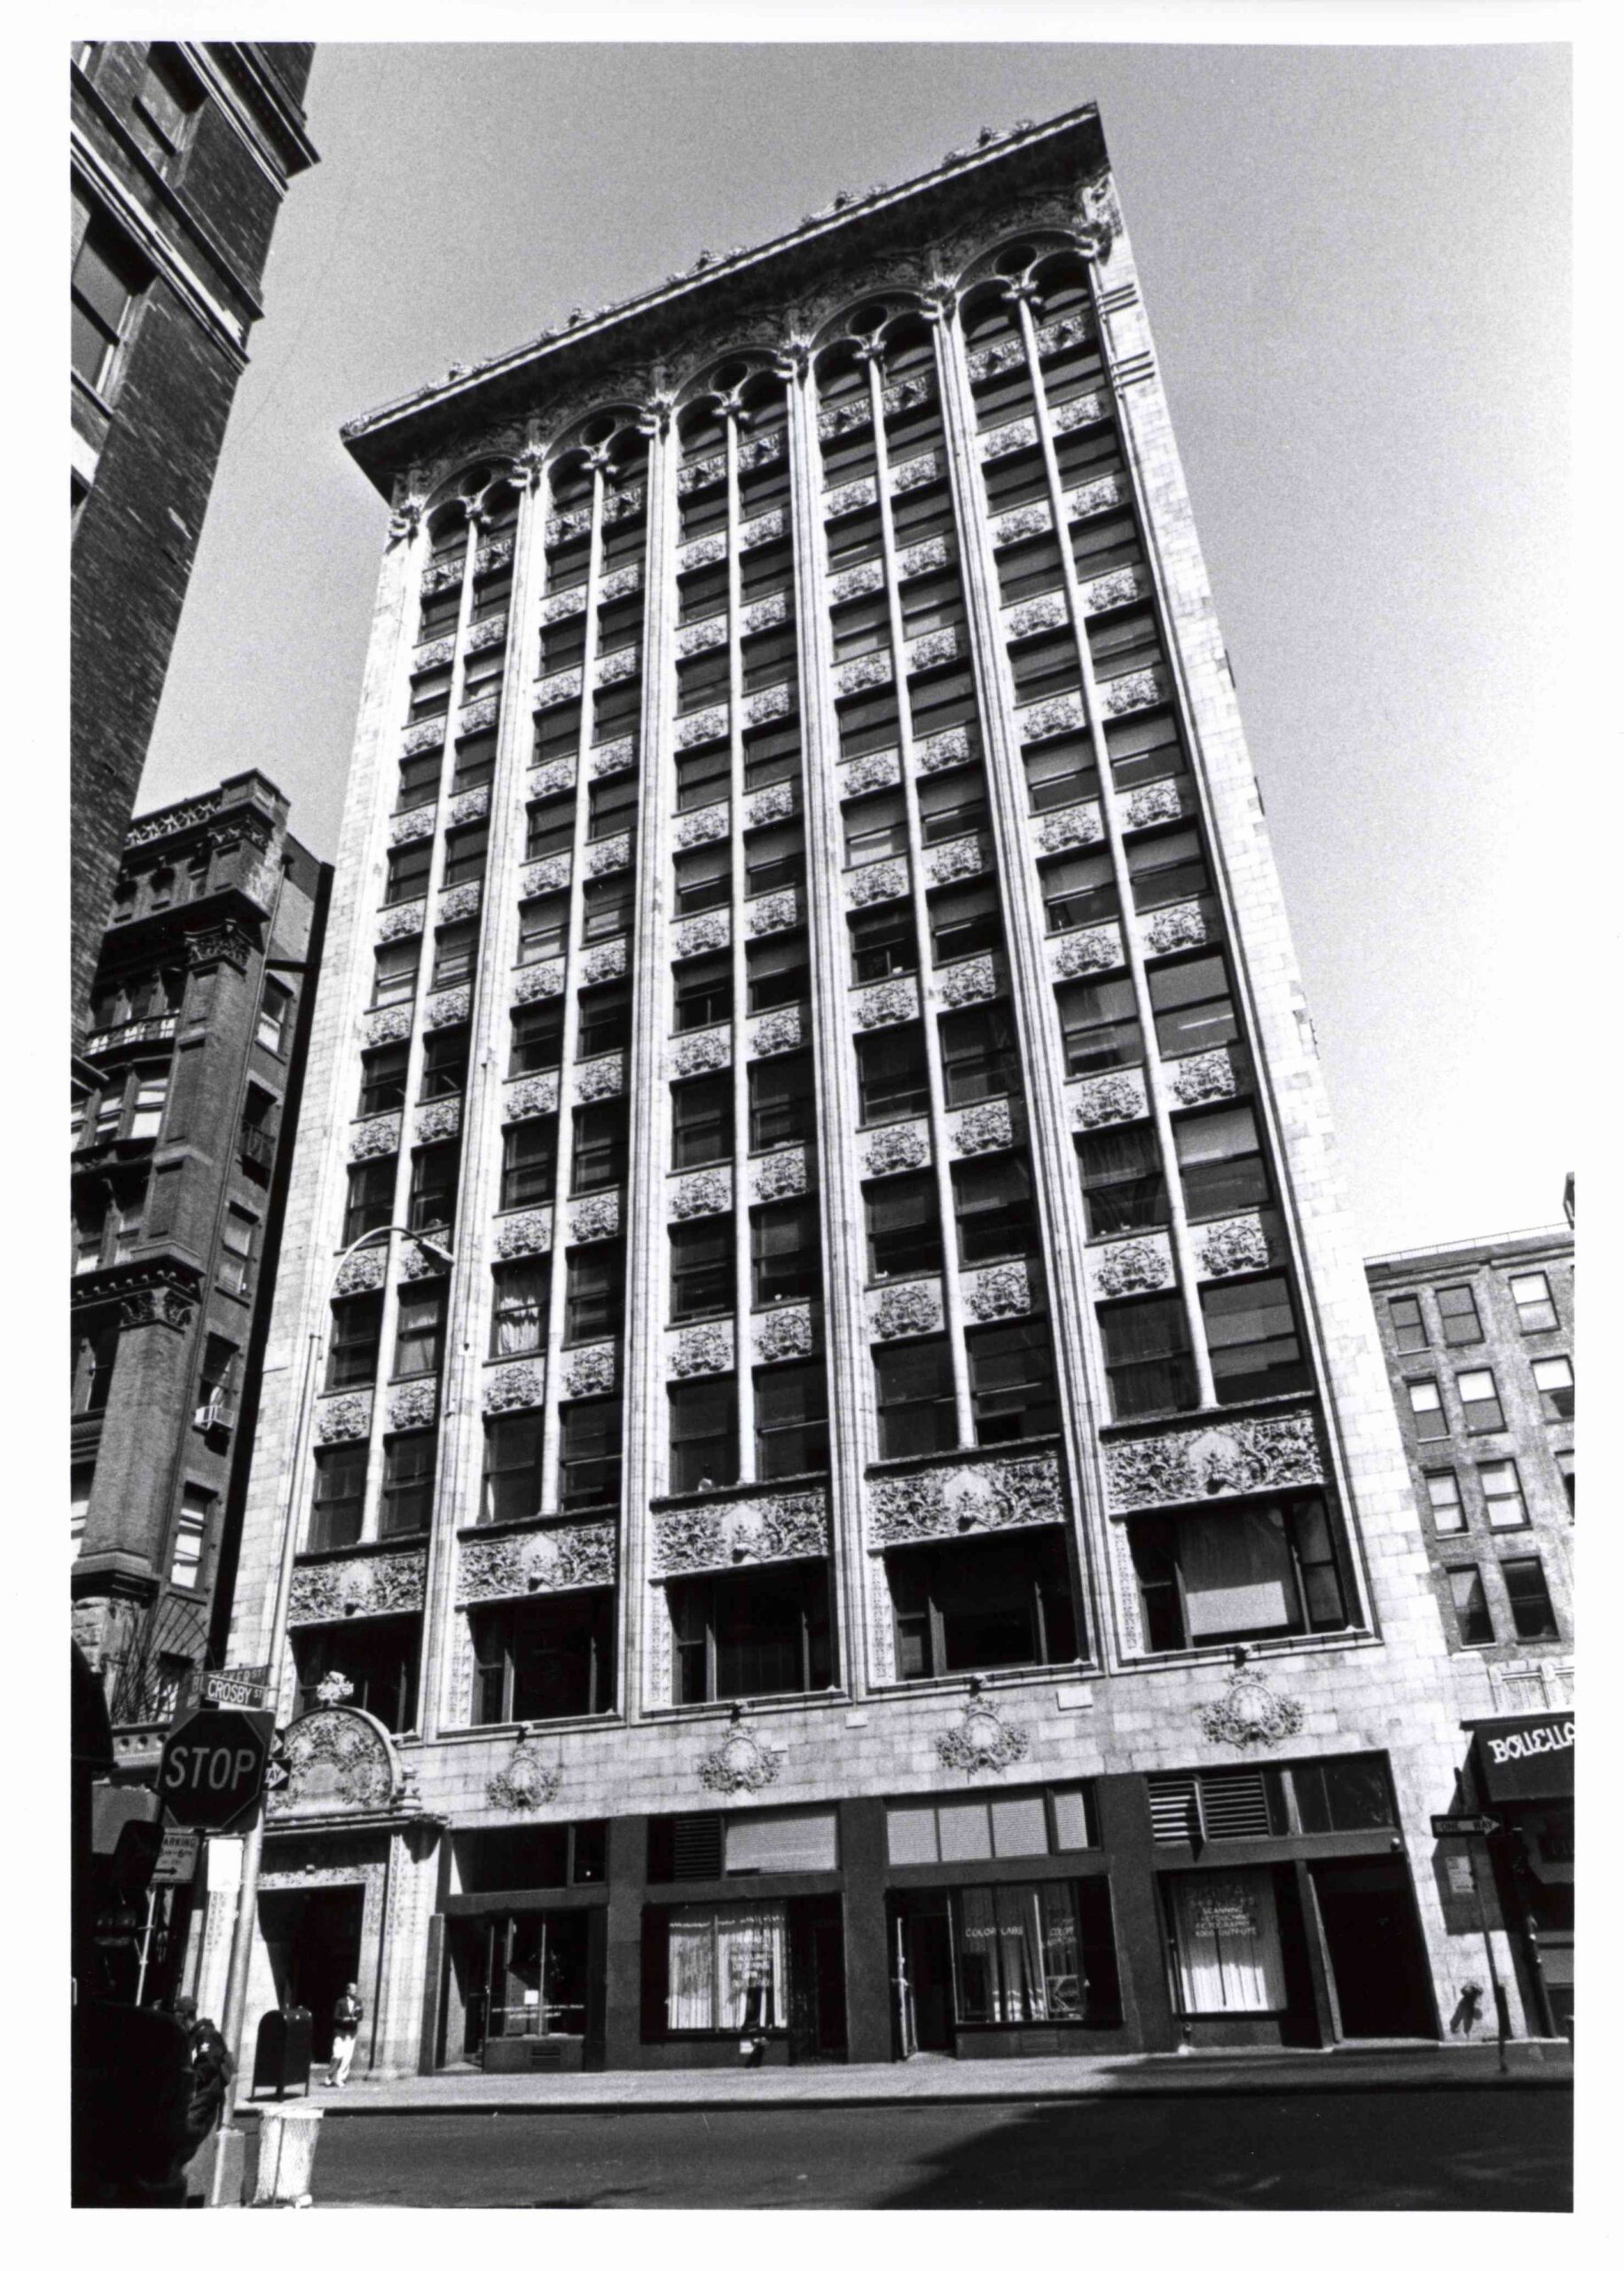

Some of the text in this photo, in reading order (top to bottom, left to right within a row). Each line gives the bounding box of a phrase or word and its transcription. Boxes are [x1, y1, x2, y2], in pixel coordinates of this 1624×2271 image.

[252, 1669, 263, 1679] ST
[208, 1678, 263, 1705] CROSBY ST
[165, 1746, 256, 1790] STOP
[1441, 1819, 1494, 1832] ONE WAY
[163, 1836, 195, 1848] ARKING
[965, 1927, 997, 1937] COLOR
